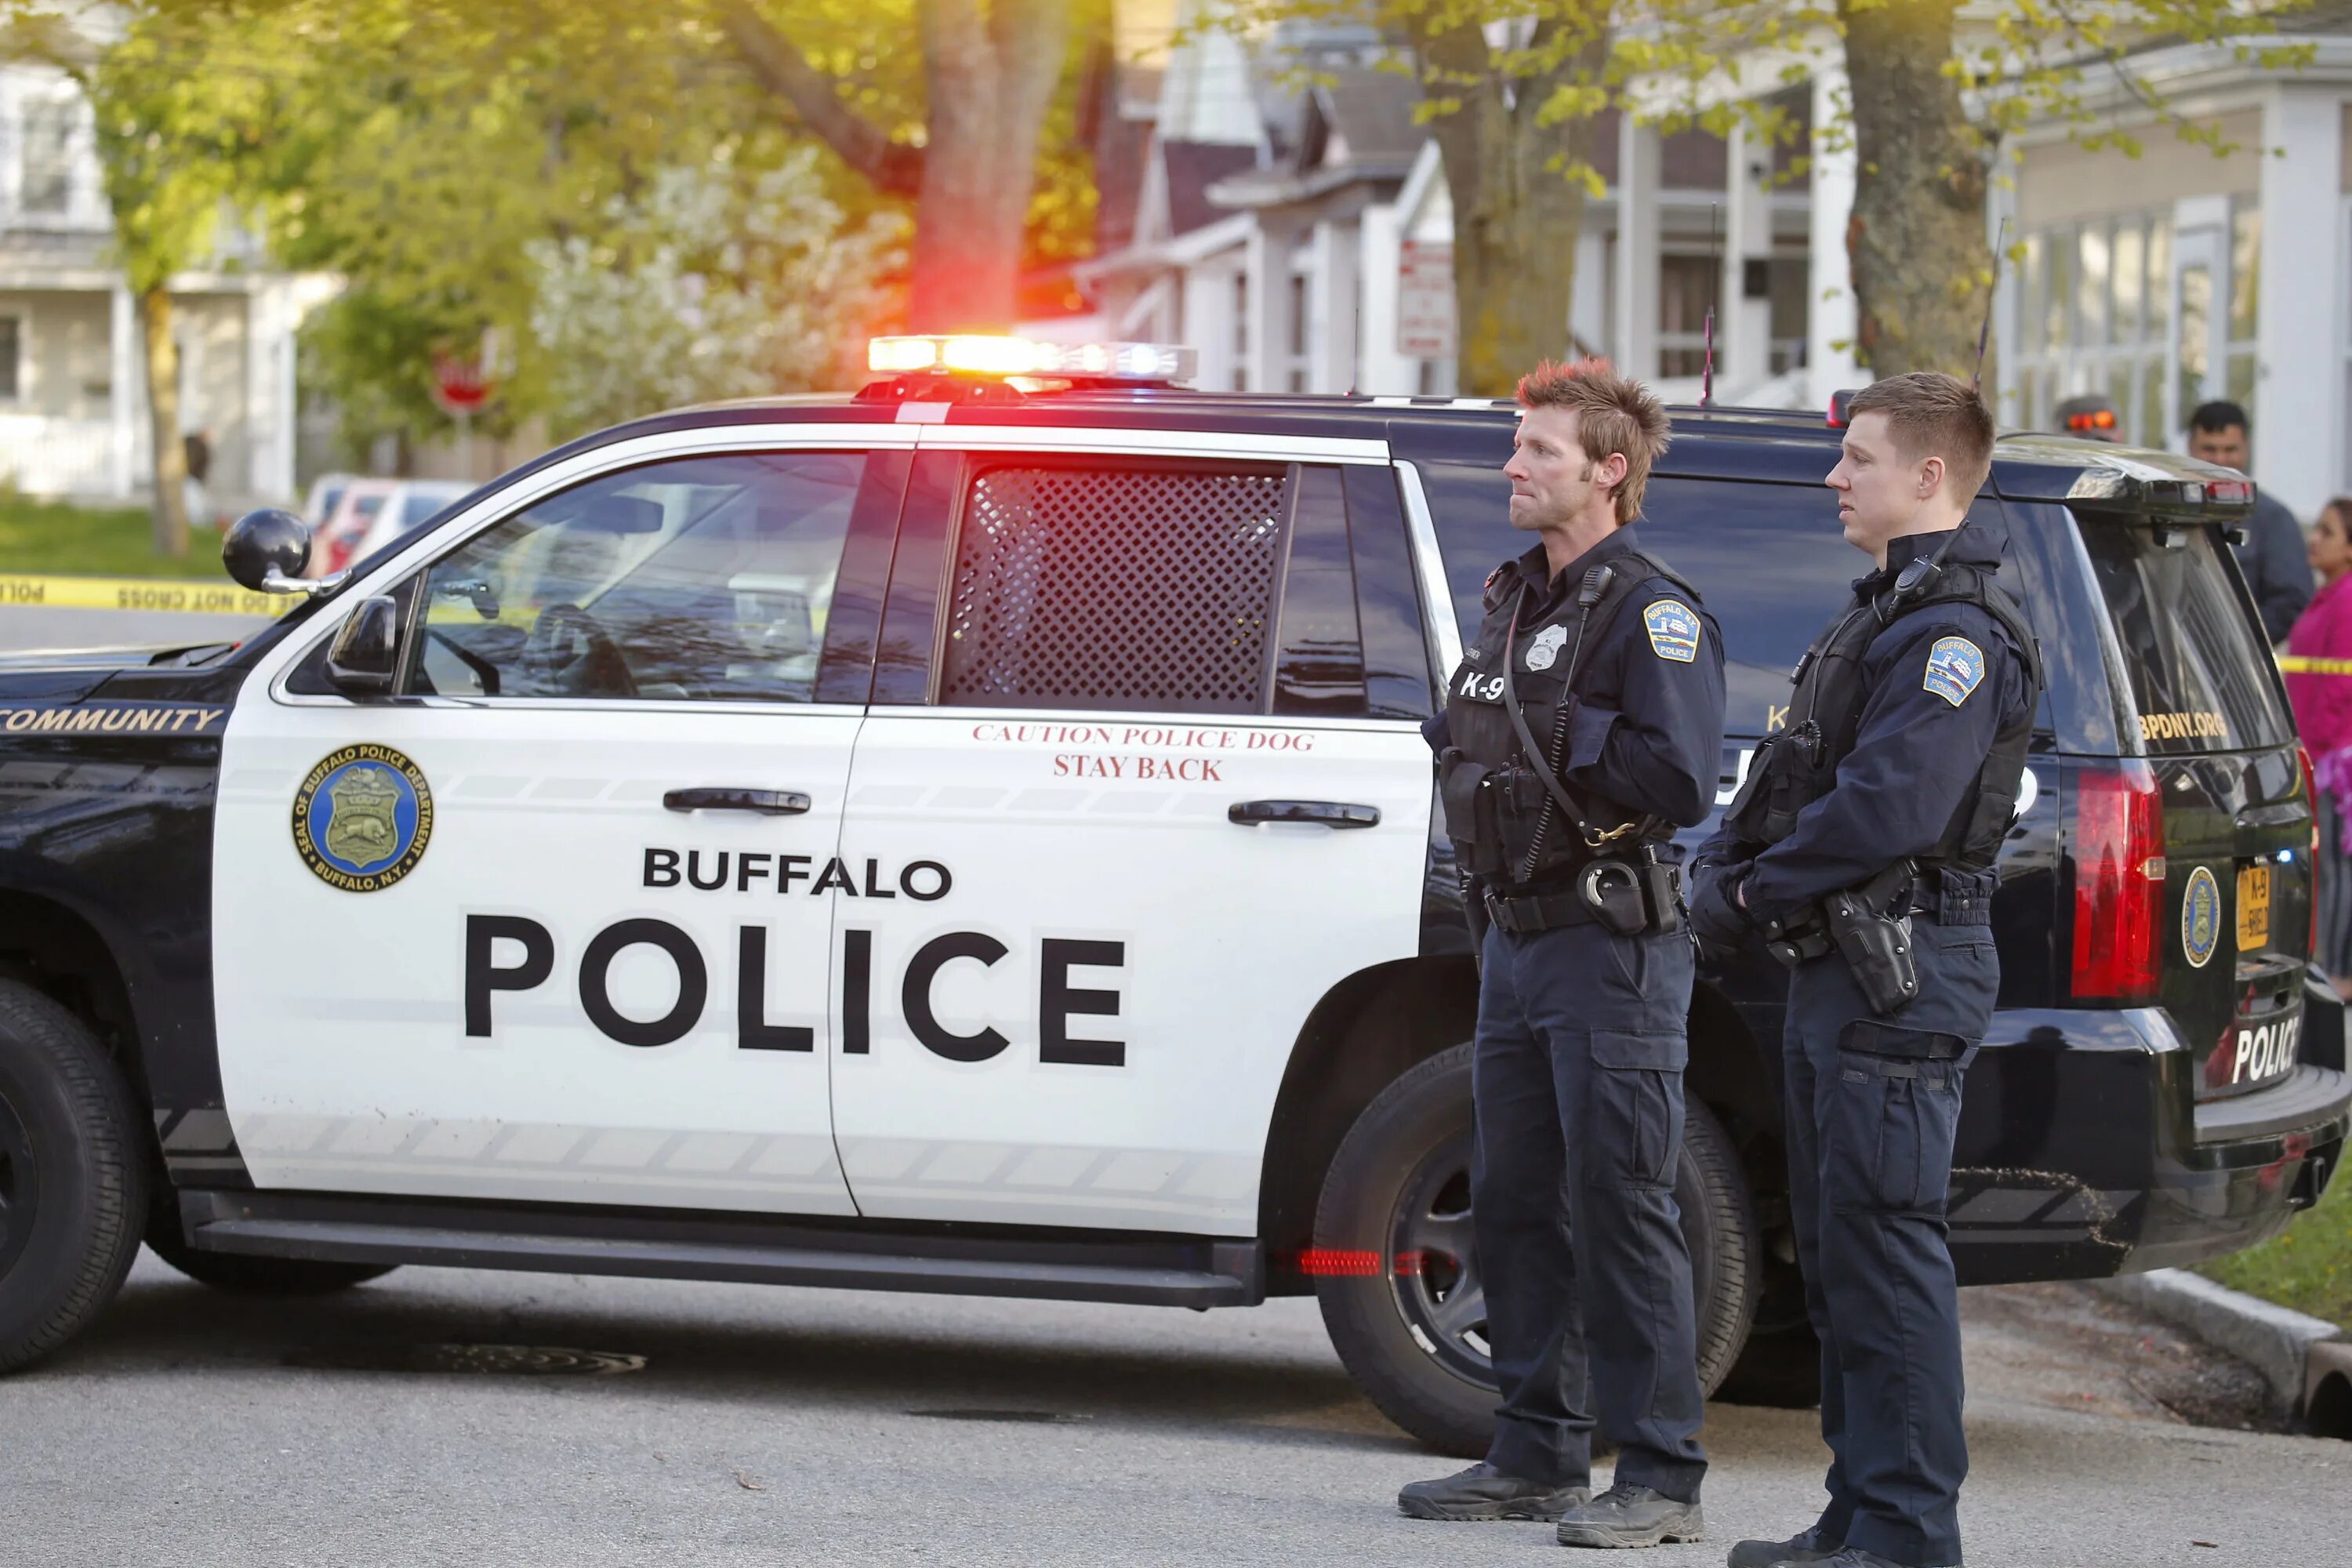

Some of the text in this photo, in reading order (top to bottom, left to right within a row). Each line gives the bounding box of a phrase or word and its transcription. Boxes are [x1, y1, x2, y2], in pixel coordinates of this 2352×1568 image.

[118, 587, 185, 609] CROSS
[194, 589, 233, 610] NOT
[241, 591, 270, 612] DO
[1661, 646, 1689, 657] POLICE
[1460, 672, 1504, 700] K-9
[1931, 679, 1959, 701] POLICE
[972, 724, 1316, 753] CAUTION POLICE DOG
[2138, 712, 2228, 741] BPDNY.ORG
[303, 747, 356, 793] BUFFALO
[360, 746, 406, 768] POLICE
[1053, 753, 1224, 782] STAY BACK
[296, 797, 309, 816] OF
[405, 766, 432, 858] DEPARTMENT
[296, 820, 313, 854] SEAL
[315, 862, 408, 891] BUFFALO, N.Y.
[644, 849, 952, 901] BUFFALO
[466, 915, 1125, 1066] POLICE
